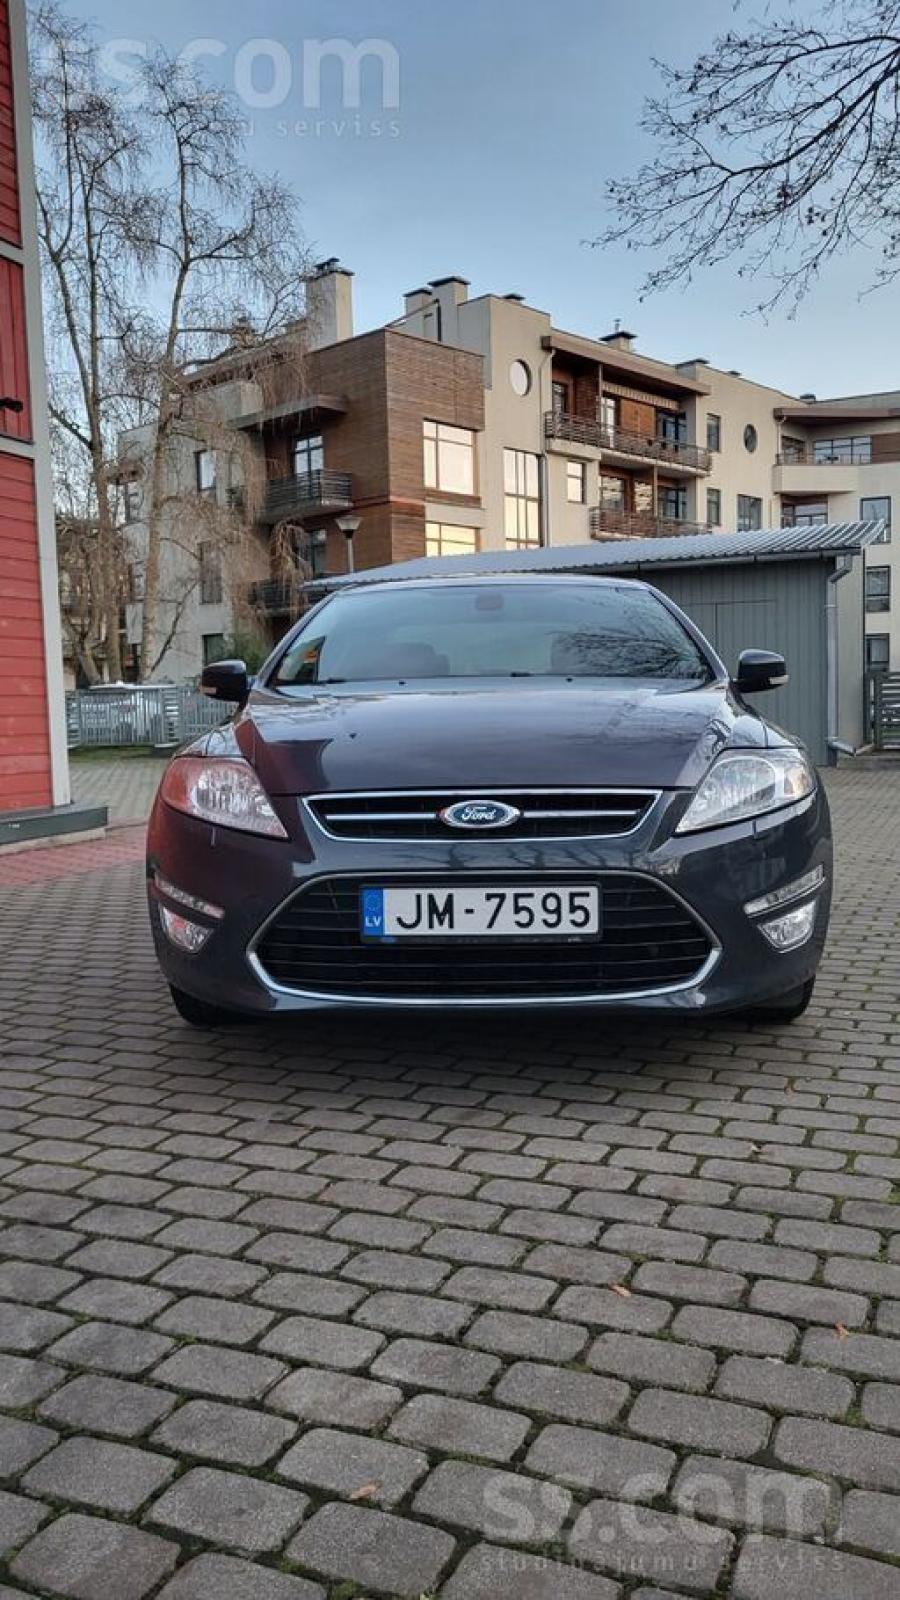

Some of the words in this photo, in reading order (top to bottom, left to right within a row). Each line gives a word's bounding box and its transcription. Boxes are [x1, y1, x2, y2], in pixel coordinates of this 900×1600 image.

[461, 806, 497, 820] Ford
[396, 892, 591, 930] JM-7595
[365, 917, 382, 927] LV
